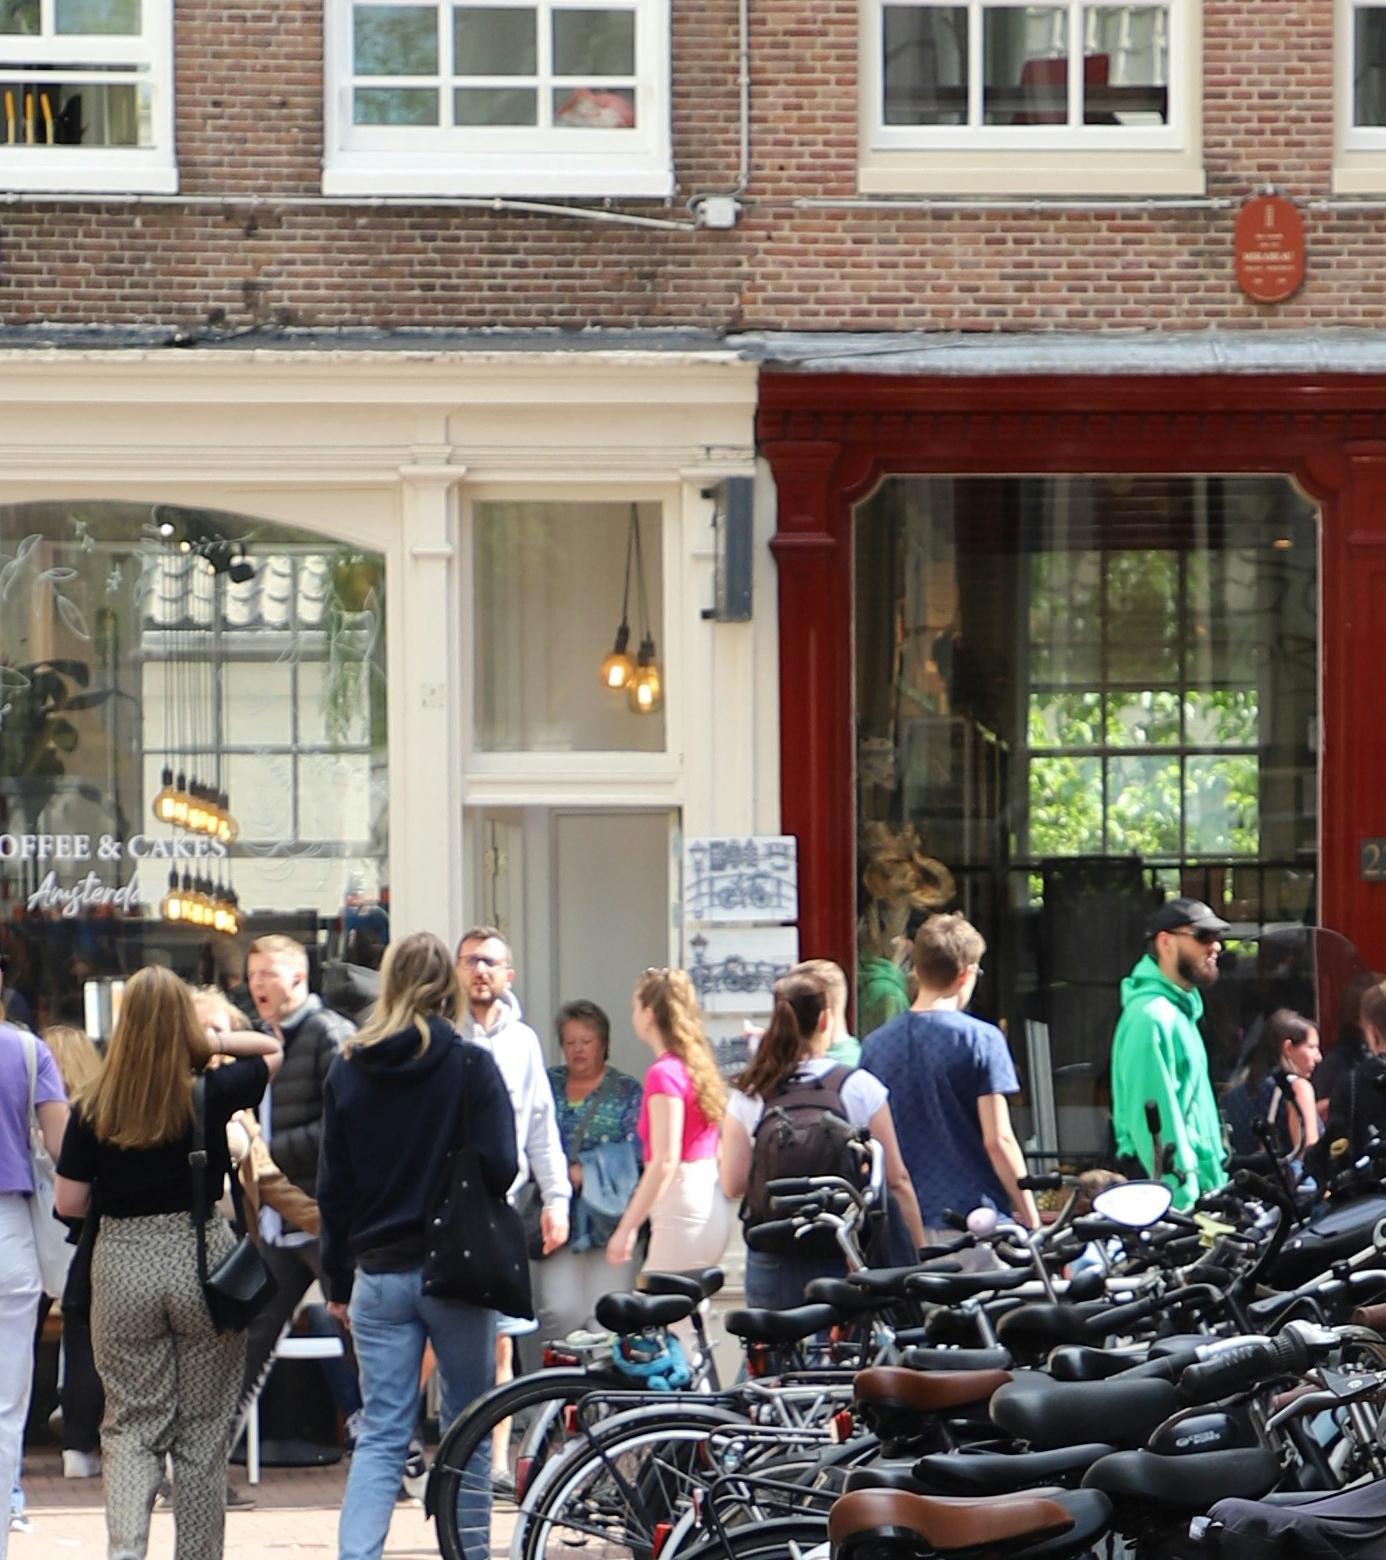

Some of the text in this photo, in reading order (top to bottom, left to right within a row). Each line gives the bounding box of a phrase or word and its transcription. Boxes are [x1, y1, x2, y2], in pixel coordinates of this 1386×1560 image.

[96, 833, 122, 860] &
[127, 833, 227, 859] CAKES
[26, 869, 158, 918] Amsterda
